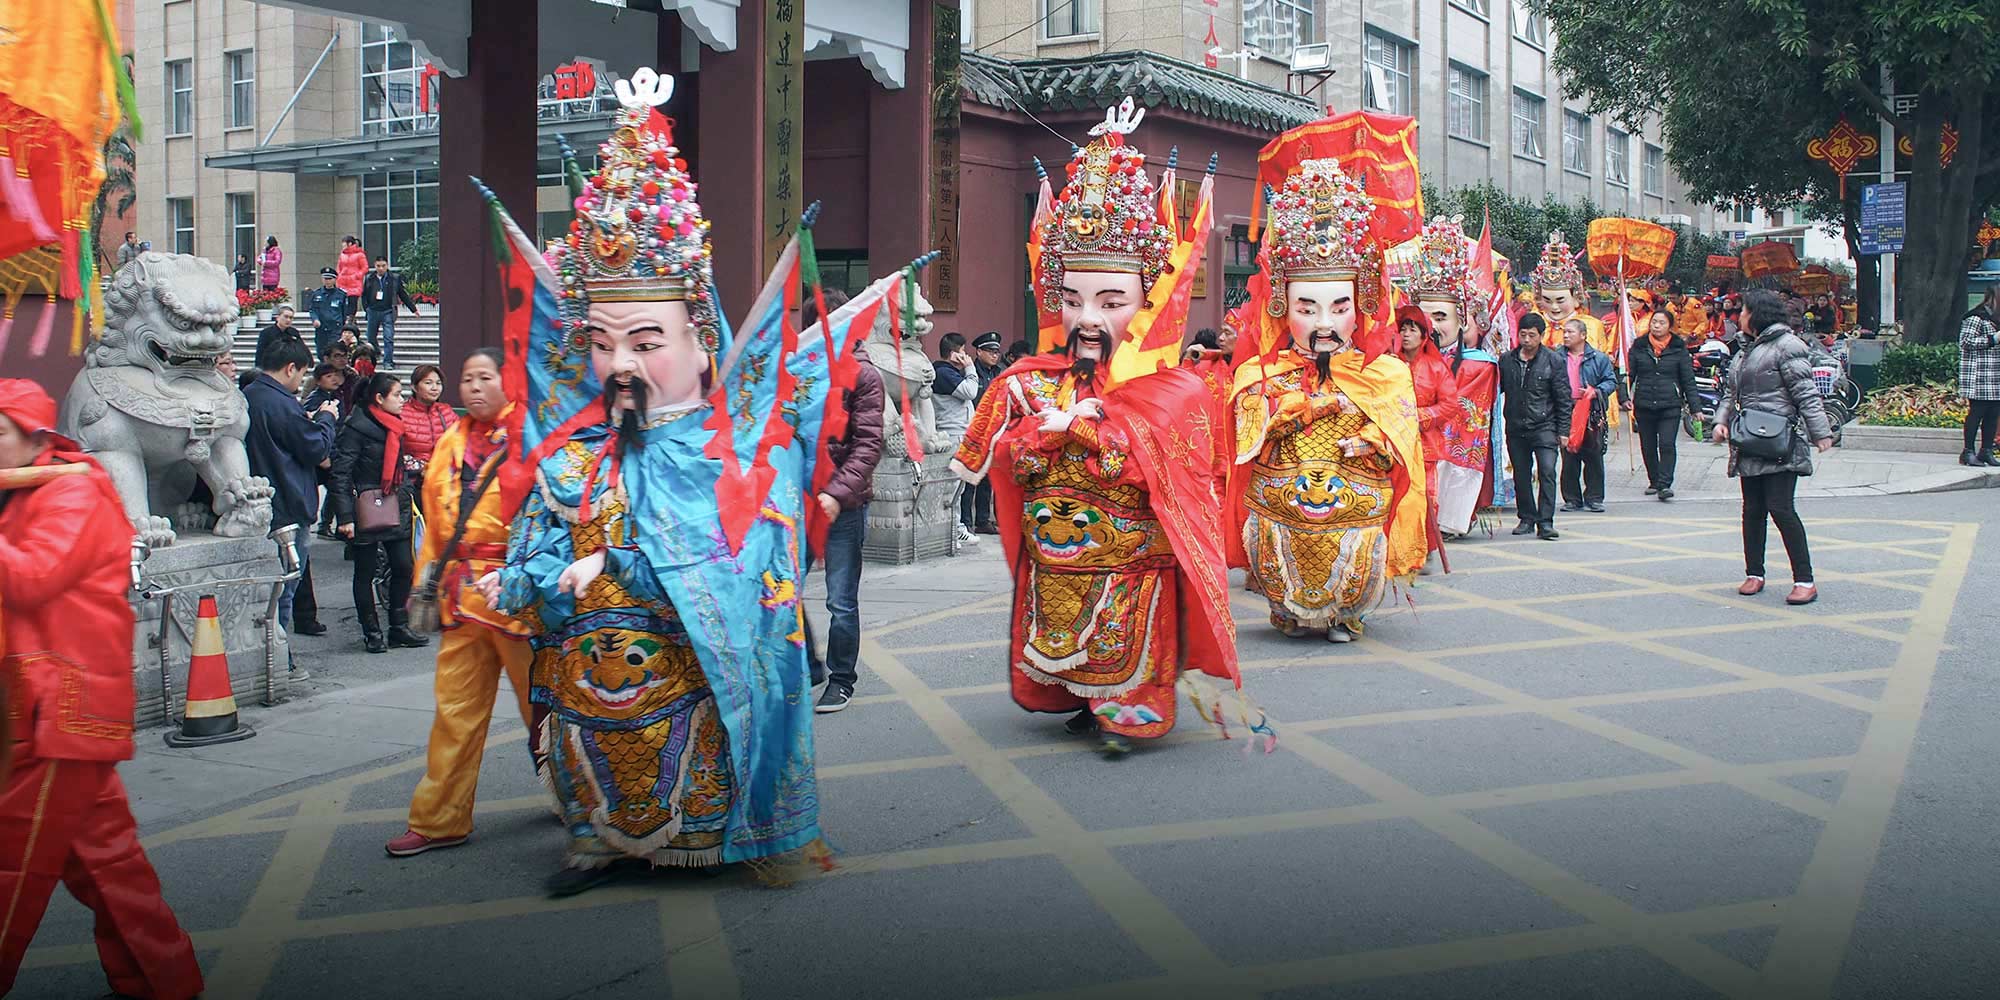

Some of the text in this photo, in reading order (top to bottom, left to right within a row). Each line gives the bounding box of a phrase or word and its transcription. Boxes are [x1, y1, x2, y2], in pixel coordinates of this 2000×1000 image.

[775, 0, 793, 261] 福建中醫藥大
[1829, 135, 1854, 158] 福
[1865, 187, 1874, 201] P
